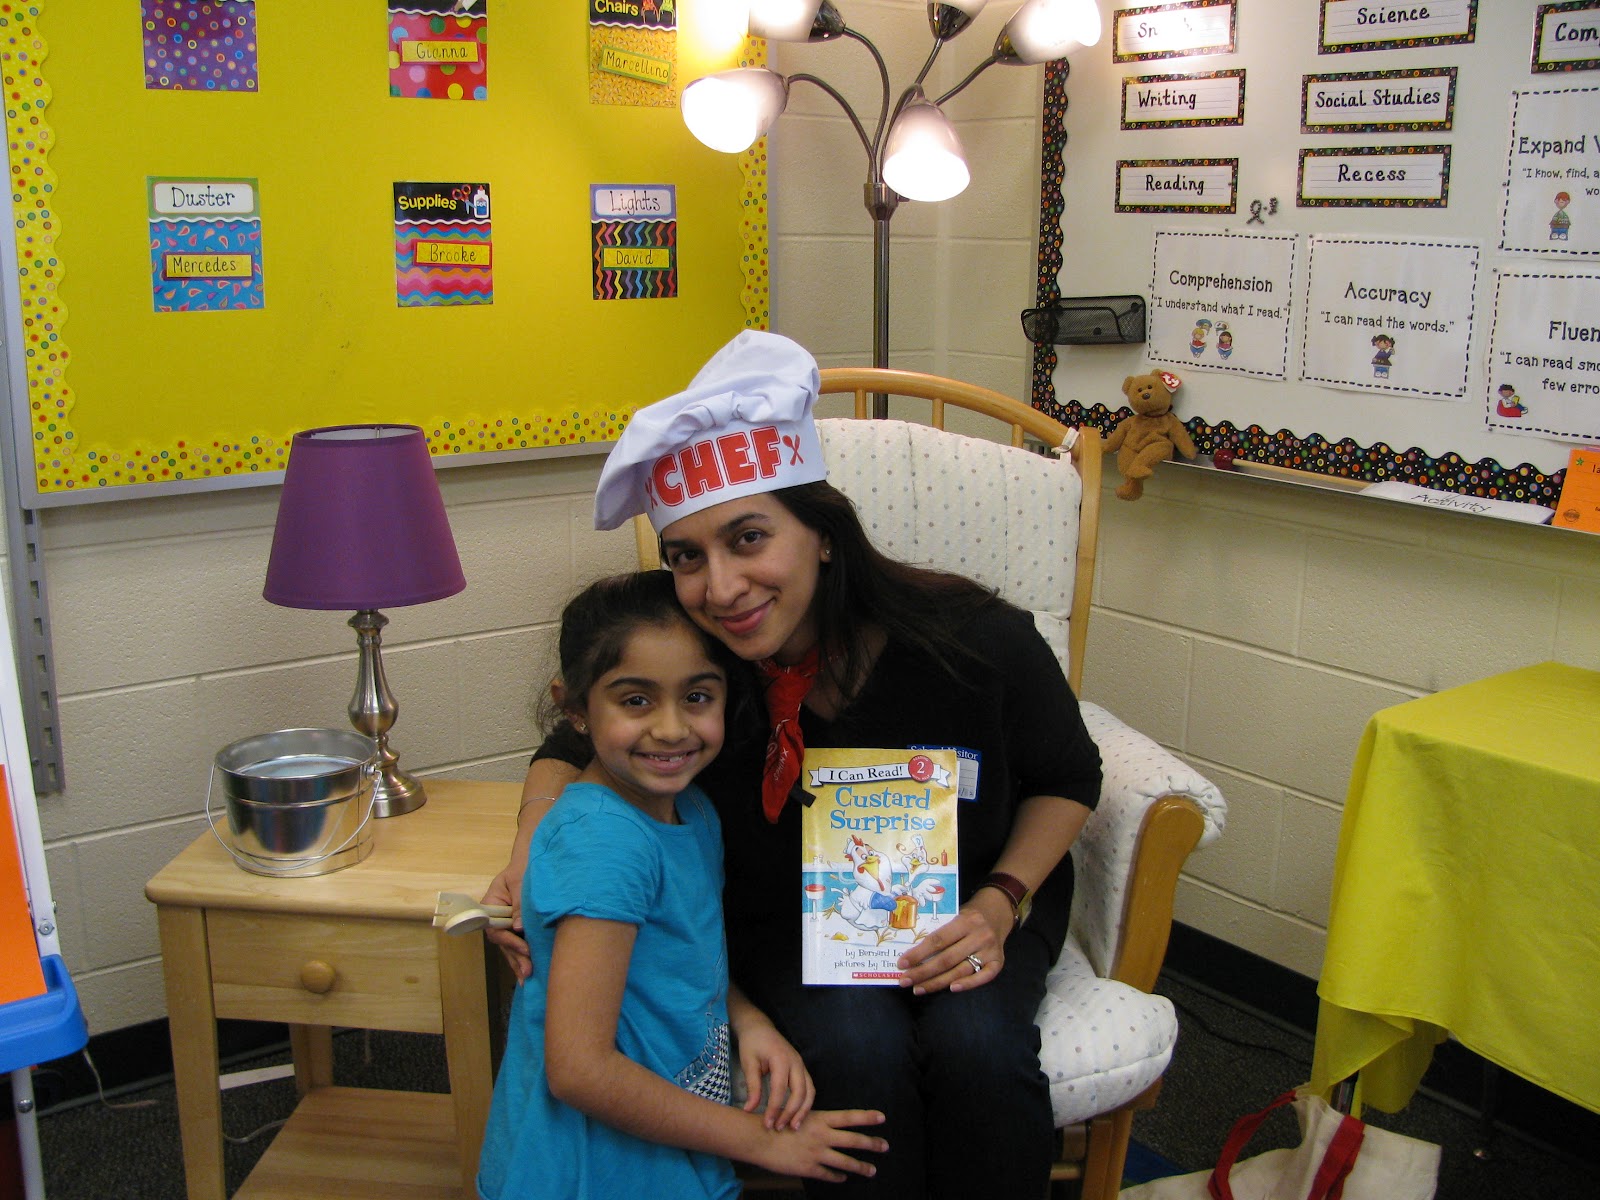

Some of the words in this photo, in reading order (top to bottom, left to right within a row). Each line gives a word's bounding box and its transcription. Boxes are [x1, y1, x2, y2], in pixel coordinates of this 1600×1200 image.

[595, 0, 639, 16] Chairs
[1357, 7, 1430, 25] Science
[1555, 22, 1600, 46] Com
[416, 42, 468, 59] Gianna
[605, 51, 669, 79] Marcellino
[1138, 88, 1197, 110] Writing
[1315, 90, 1367, 108] Social
[1373, 87, 1440, 106] Studies
[1518, 135, 1586, 159] Expand
[1337, 163, 1406, 182] Recess
[1535, 168, 1563, 179] know,
[1566, 167, 1589, 179] find,
[1145, 174, 1205, 196] Reading
[1585, 188, 1600, 196] wo
[171, 185, 235, 208] Duster
[398, 194, 457, 211] Supplies
[610, 190, 660, 216] Lights
[430, 243, 476, 262] Brooke
[616, 249, 653, 265] David
[173, 256, 237, 274] Mercedes
[1169, 270, 1273, 293] Comprehension
[1344, 281, 1431, 309] Accuracy
[1165, 298, 1218, 313] understand
[1221, 304, 1245, 316] what
[1247, 305, 1254, 316] I
[1334, 314, 1353, 326] can
[1356, 316, 1382, 328] read
[1386, 316, 1405, 329] the
[1548, 320, 1600, 342] Fluen
[1515, 356, 1538, 367] can
[1542, 356, 1573, 370] read
[1542, 377, 1566, 392] few
[1570, 383, 1600, 394] erro
[651, 426, 782, 507] CHEF
[829, 770, 835, 781] I
[838, 770, 864, 781] Can
[867, 766, 903, 779] Read!
[916, 761, 926, 774] 2
[835, 786, 931, 811] Custard
[830, 809, 936, 834] Surprise
[845, 948, 856, 959] by
[858, 949, 890, 957] Bernard
[893, 949, 904, 957] Lo
[834, 960, 866, 969] pictures
[868, 960, 878, 970] by
